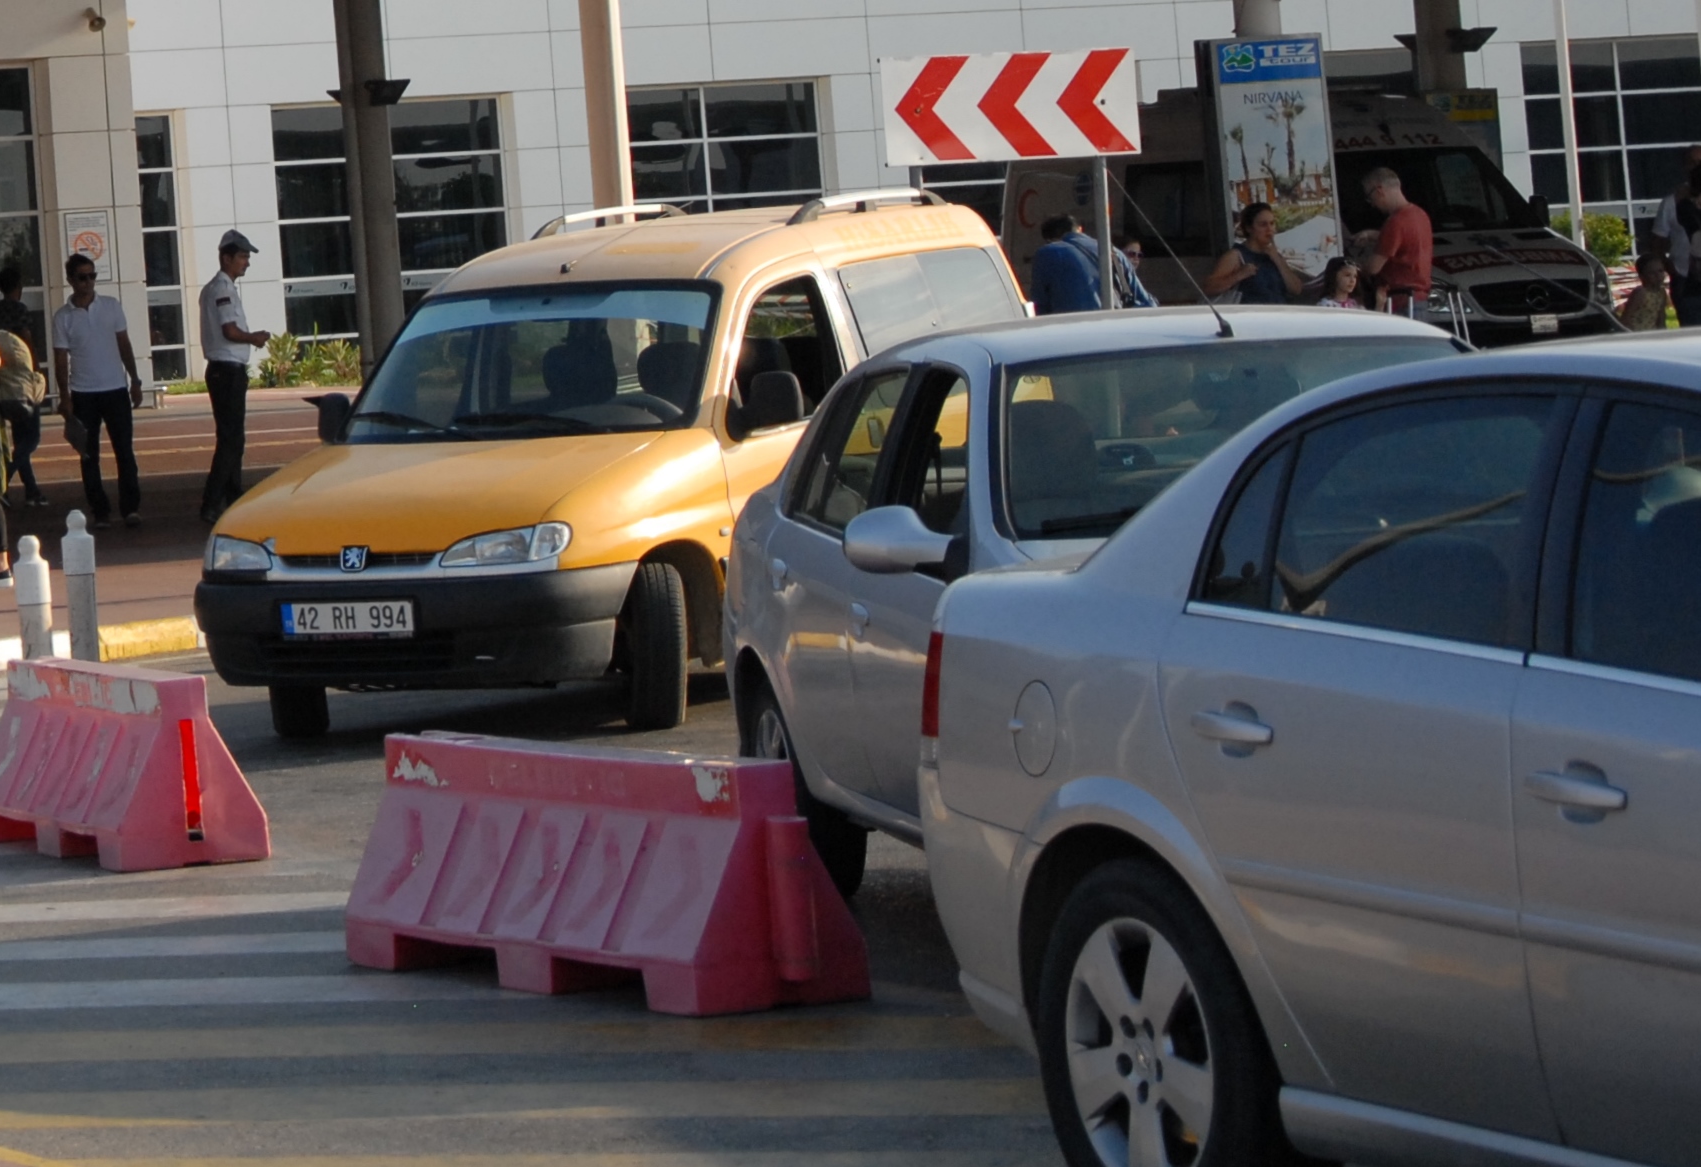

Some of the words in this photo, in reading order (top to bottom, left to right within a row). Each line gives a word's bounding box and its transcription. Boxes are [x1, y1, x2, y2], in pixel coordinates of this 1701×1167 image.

[1258, 43, 1316, 58] TEZ
[1243, 91, 1304, 105] NIRVANA
[1402, 133, 1443, 145] 112
[298, 607, 320, 630] 42
[332, 606, 357, 630] RH
[369, 605, 407, 629] 994
